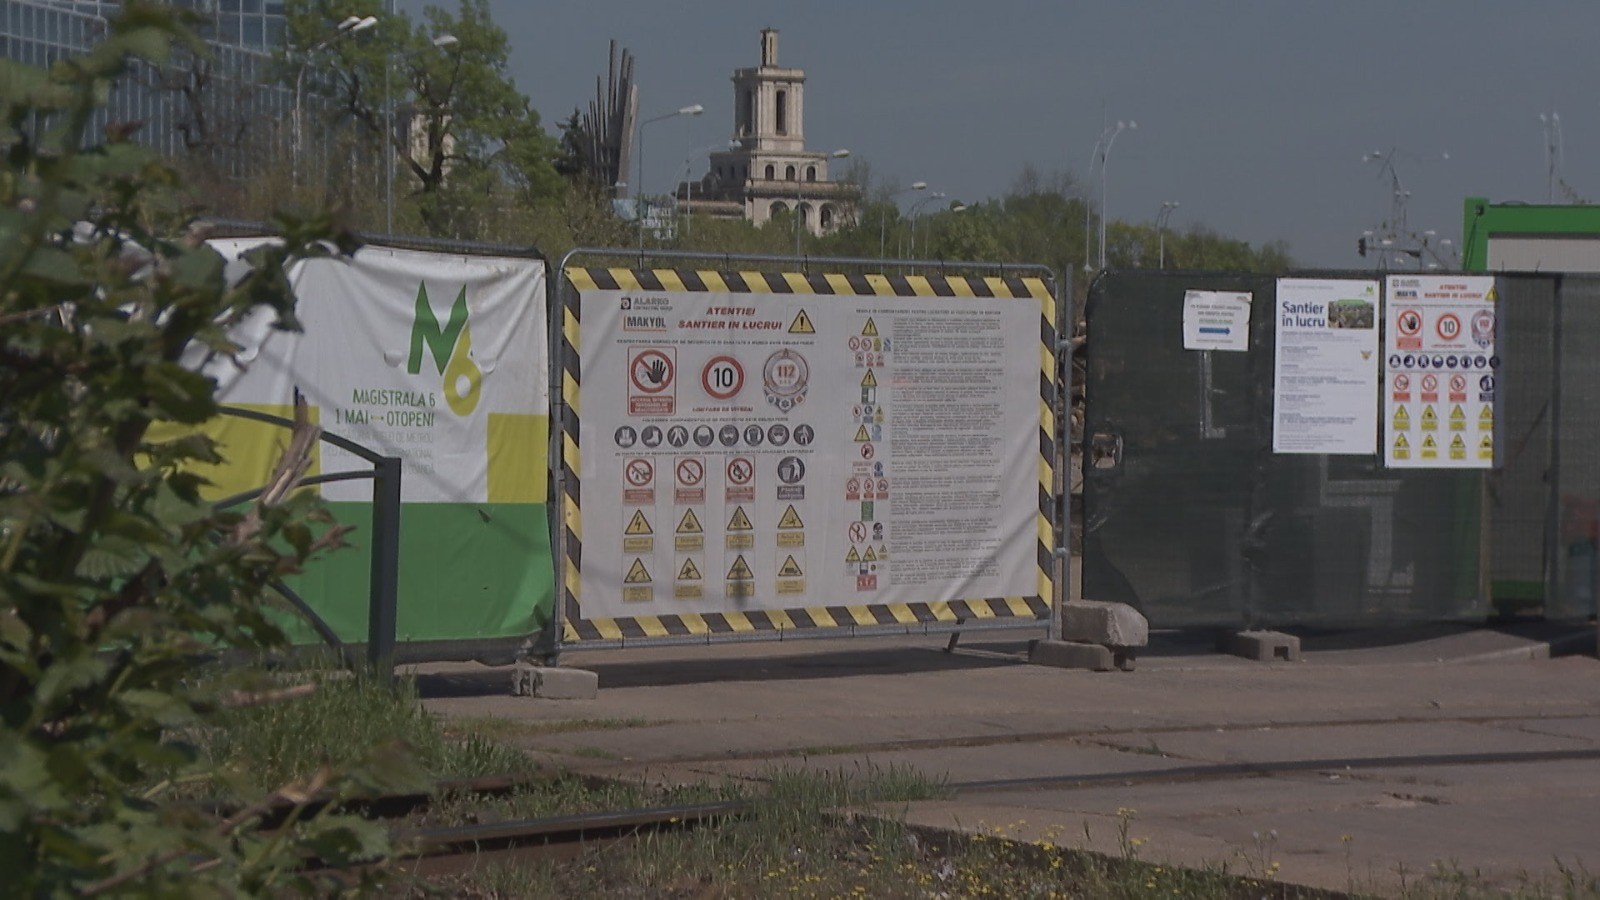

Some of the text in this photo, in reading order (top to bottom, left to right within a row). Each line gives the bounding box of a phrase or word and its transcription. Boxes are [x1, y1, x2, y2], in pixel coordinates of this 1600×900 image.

[627, 316, 667, 328] MAKYOL
[678, 320, 726, 329] SANTIER
[728, 321, 740, 329] IN
[1295, 315, 1326, 327] lucru
[1443, 320, 1455, 334] 10
[713, 367, 733, 388] 10
[352, 387, 436, 407] MAGISTRALA 6
[336, 408, 435, 427] 1 MAI OTOPENI
